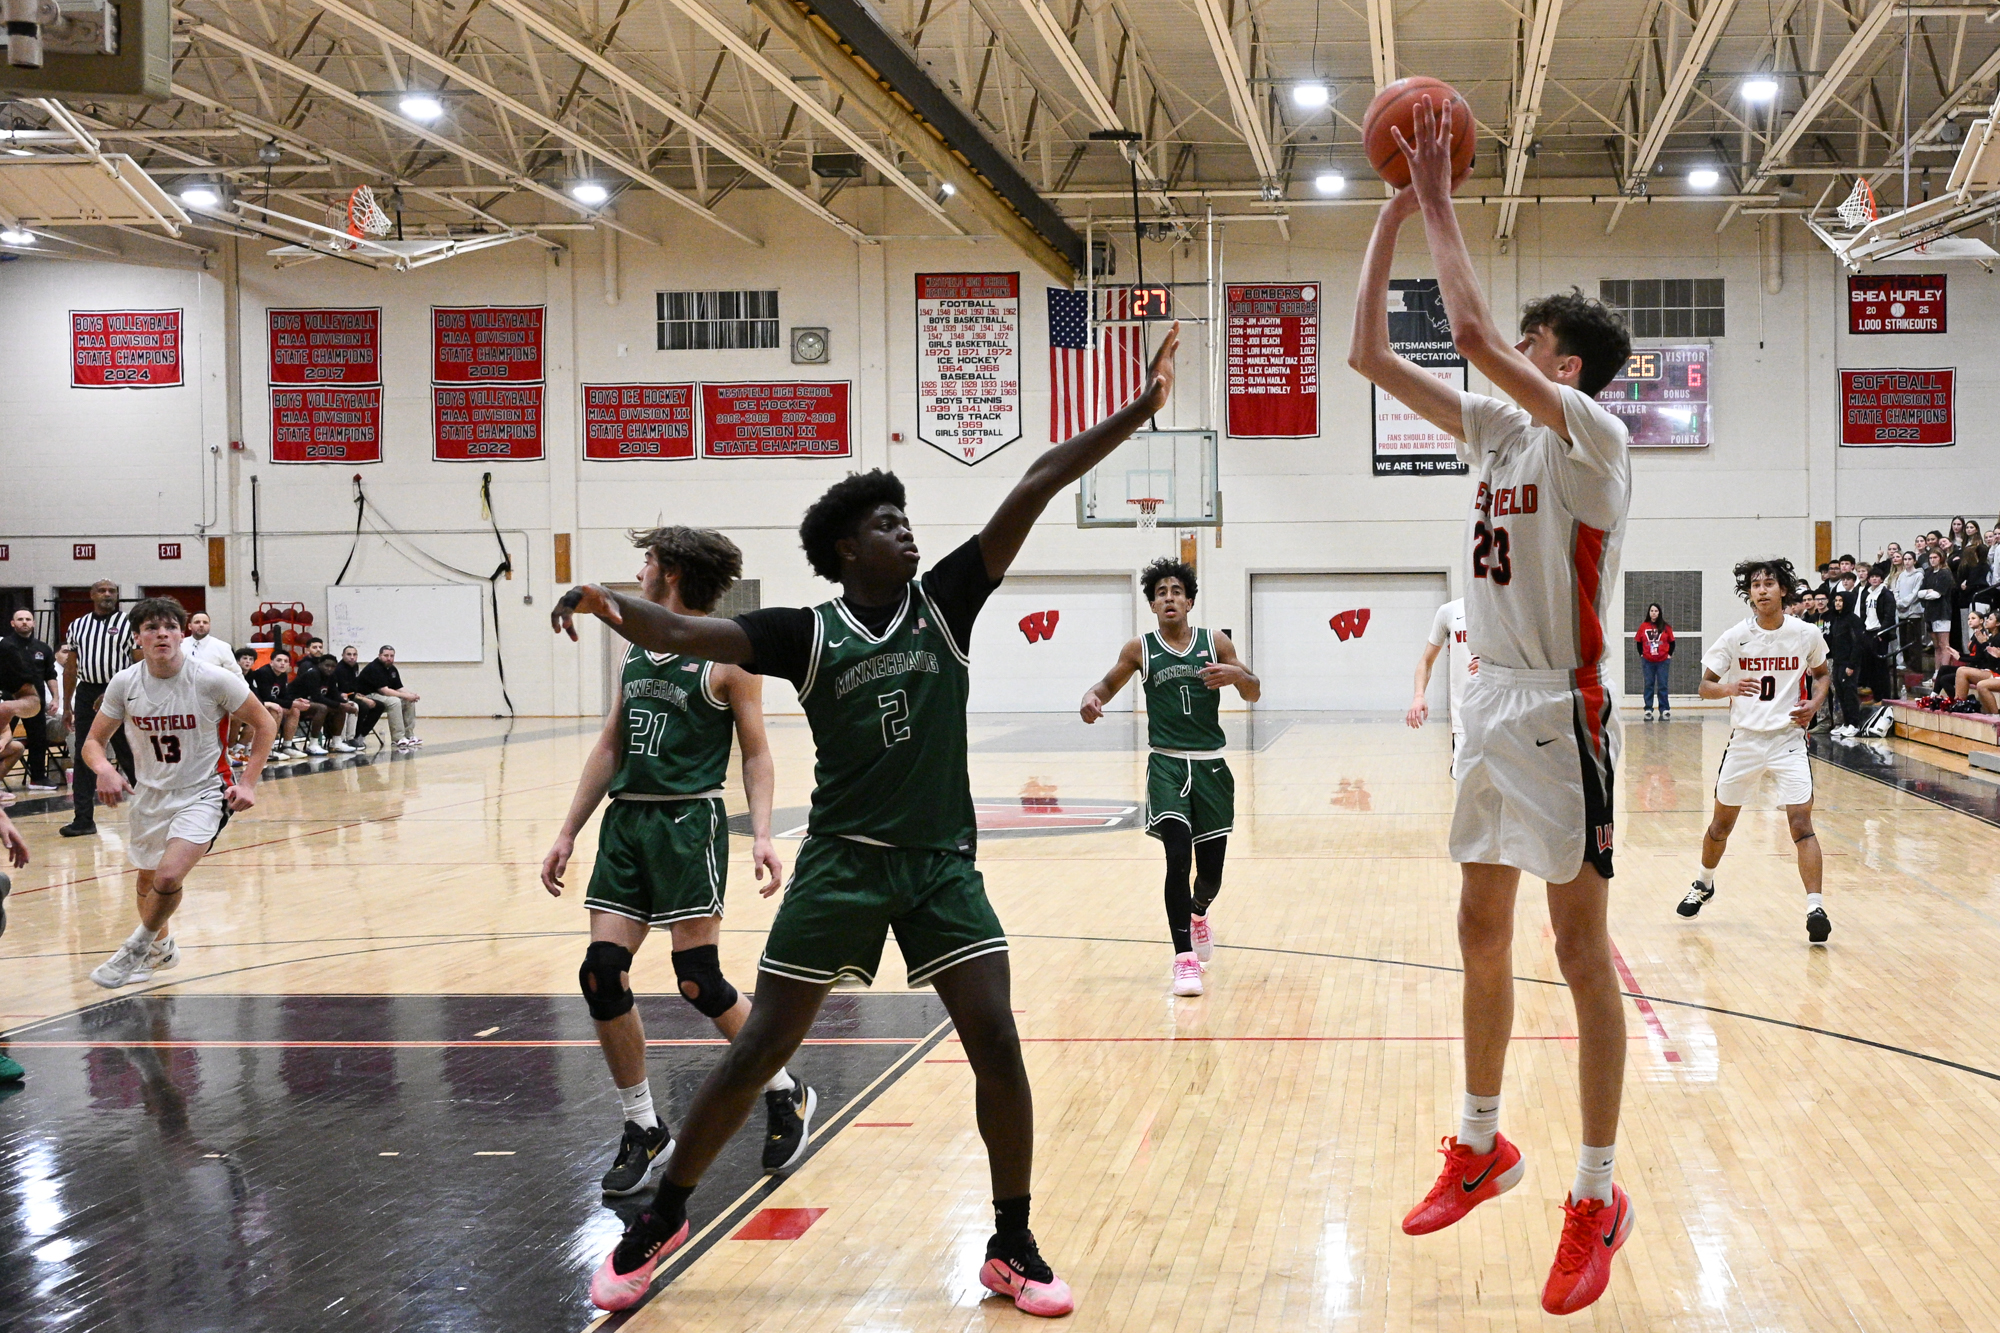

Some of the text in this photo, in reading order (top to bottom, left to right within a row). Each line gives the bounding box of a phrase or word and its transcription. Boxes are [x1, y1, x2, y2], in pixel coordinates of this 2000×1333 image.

[1855, 279, 1939, 290] SOFTBALL
[1245, 288, 1300, 299] BOMBERS
[1852, 290, 1942, 302] SHEA HURLEY
[1134, 289, 1166, 316] 27
[1254, 302, 1277, 313] POINT
[1281, 302, 1316, 312] SCORERS
[1866, 307, 1876, 315] 20
[75, 316, 177, 332] BOYS VOLLEYBALL
[272, 314, 374, 329] BOYS VOLLEYBALL
[437, 312, 539, 328] BOYS VOLLEYBALL
[1858, 318, 1937, 331] 1,000 STRIKEOUTS
[78, 334, 174, 347] MIAA DIVISION II
[278, 333, 370, 345] MIAA DIVISION I
[442, 331, 534, 344] MIAA DIVISION I
[77, 350, 175, 365] STATE CHAMPIONS
[275, 349, 373, 364] STATE CHAMPIONS
[440, 347, 536, 362] STATE CHAMPIONS
[1666, 352, 1705, 362] VISITOR
[469, 366, 508, 377] 2018
[1628, 355, 1654, 377] 26
[105, 369, 150, 380] 2024
[305, 368, 345, 379] 2017
[1688, 364, 1701, 386] 6
[1853, 375, 1942, 390] SOFTBALL
[589, 389, 687, 405] BOYS ICE HOCKEY
[718, 388, 832, 398] WESTFIELD HIGH SCHOOL
[1601, 391, 1625, 399] PERIOD
[1635, 383, 1638, 400] 1
[1664, 390, 1690, 398] BONUS
[274, 393, 378, 408] BOYS VOLLEYBALL
[437, 391, 539, 406] BOYS VOLLEYBALL
[734, 399, 817, 411] ICE HOCKEY
[1849, 393, 1946, 405] MIAA DIVISION II
[441, 409, 535, 422] MIAA DIVISION II
[588, 408, 690, 420] MIAA DIVISION III
[1617, 405, 1646, 413] PLAYER
[281, 412, 371, 423] MIAA DIVISION I
[782, 413, 836, 423] 2007-2008
[1849, 409, 1947, 424] STATE CHAMPIONS
[278, 427, 374, 442] STATE CHAMPIONS
[441, 424, 536, 440] STATE CHAMPIONS
[589, 423, 688, 439] STATE CHAMPIONS
[736, 426, 816, 437] DIVISION III
[1875, 428, 1920, 439] 2022
[1671, 435, 1699, 443] POINTS
[306, 446, 346, 457] 2019
[468, 443, 510, 454] 2022
[619, 442, 660, 454] 2013
[714, 440, 839, 453] STATE CHAMPIONS
[963, 448, 975, 457] W
[1376, 462, 1391, 470] WE
[1394, 462, 1412, 470] ARE
[76, 546, 93, 557] EXIT
[161, 546, 178, 556] EXIT
[1474, 520, 1512, 585] 23
[1018, 610, 1059, 644] W
[1329, 609, 1370, 642] W
[1739, 656, 1798, 671] WESTFIELD
[835, 651, 939, 699] MINNECHAUG
[1759, 676, 1775, 701] 0
[1180, 685, 1191, 714] 1
[878, 689, 910, 748] 2
[629, 709, 667, 756] 21
[150, 735, 181, 763] 13
